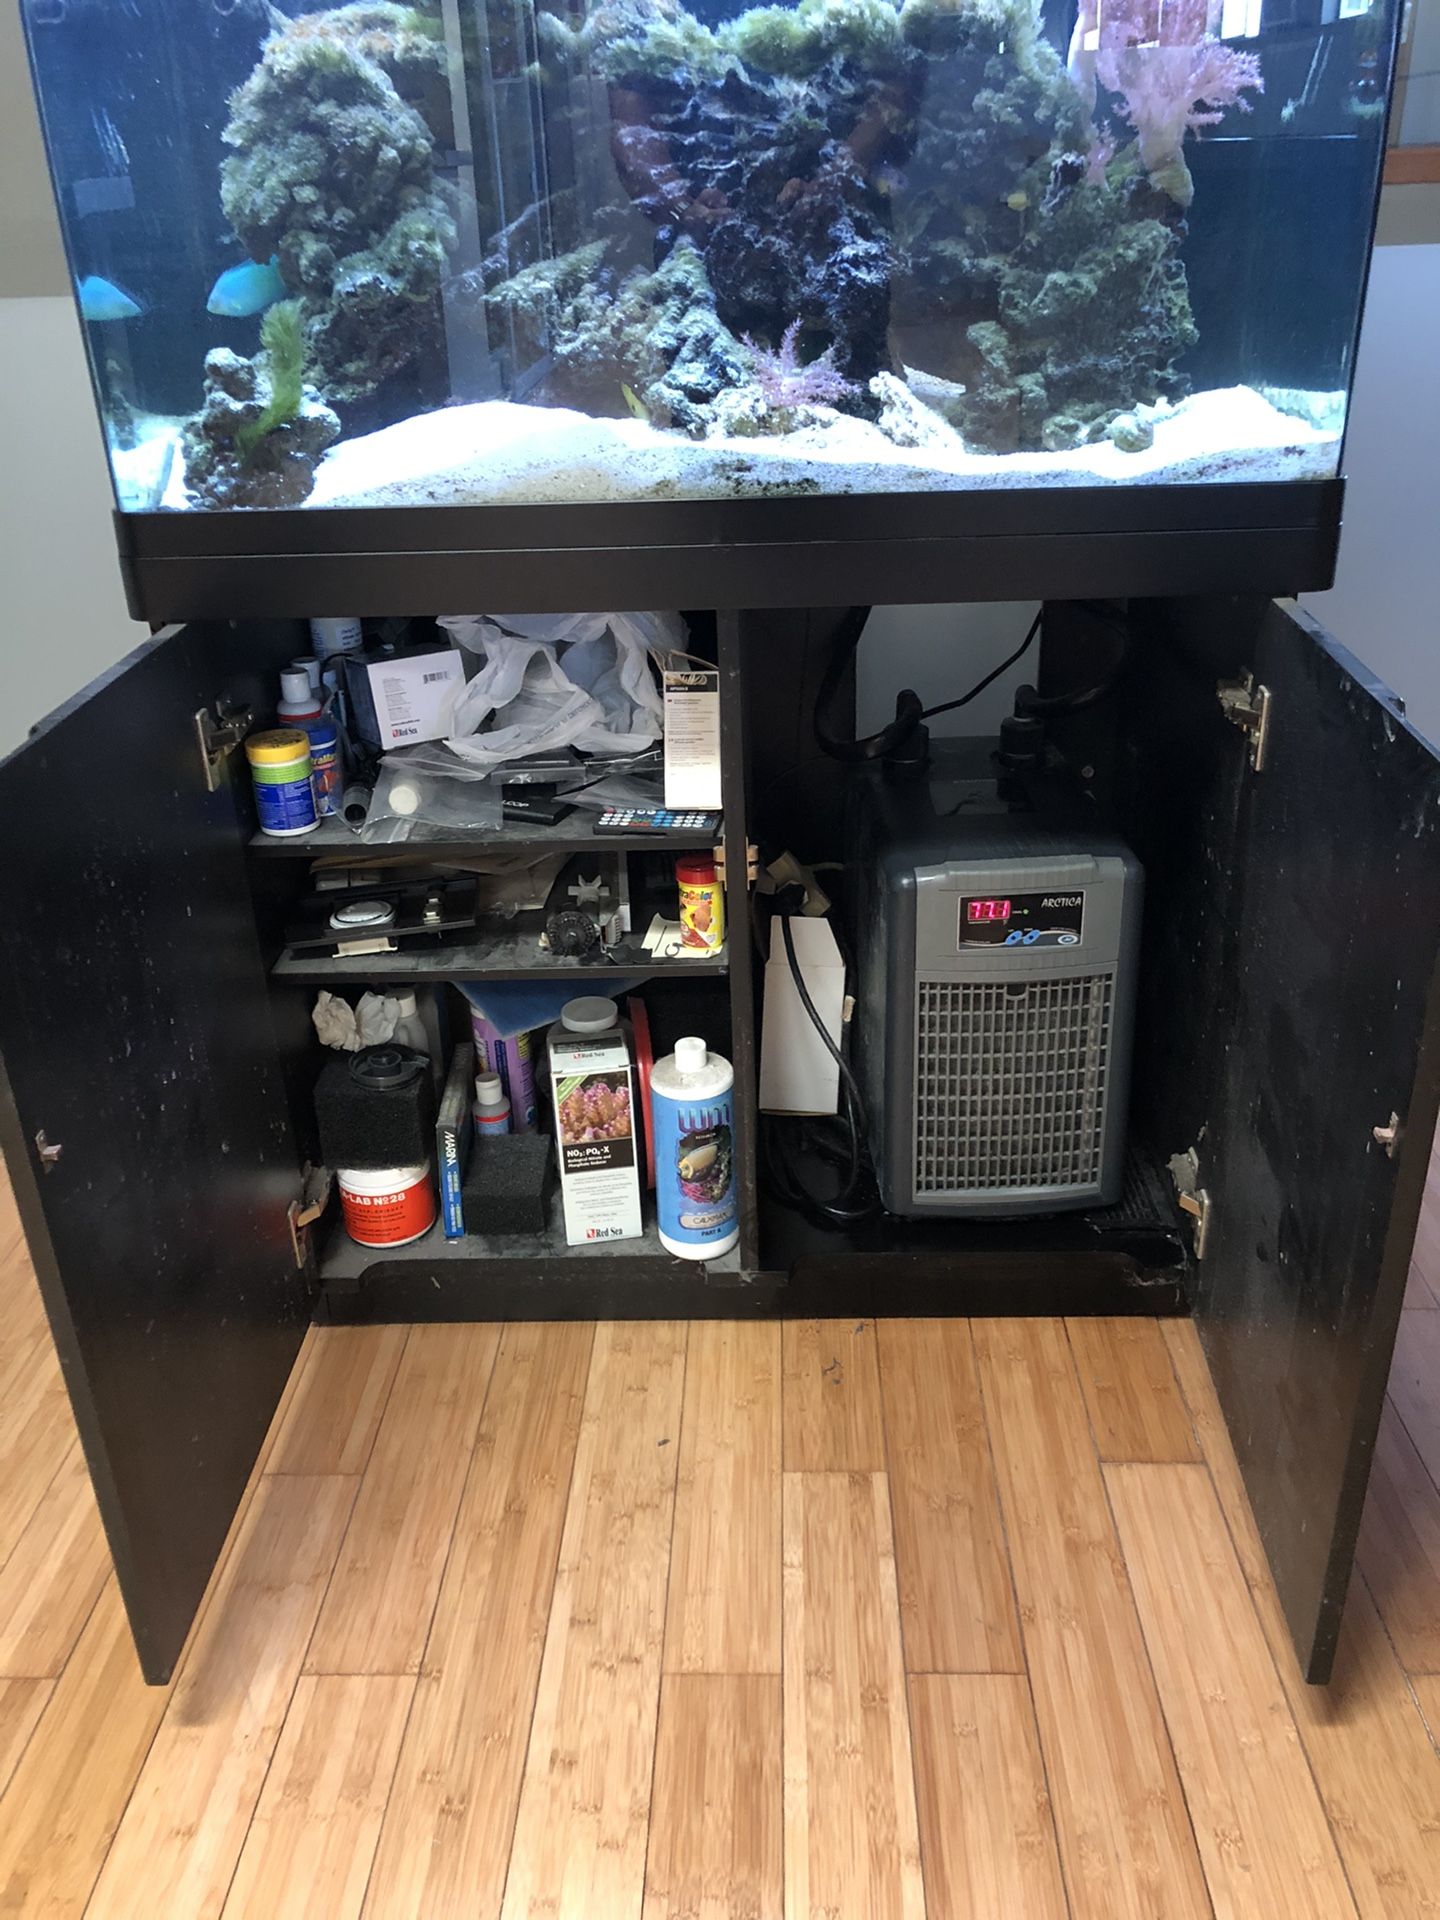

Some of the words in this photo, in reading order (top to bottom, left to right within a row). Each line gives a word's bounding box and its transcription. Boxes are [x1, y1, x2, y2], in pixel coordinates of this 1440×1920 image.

[1041, 896, 1082, 908] ARCTICA
[596, 1227, 609, 1238] Red
[610, 1226, 623, 1236] Sea
